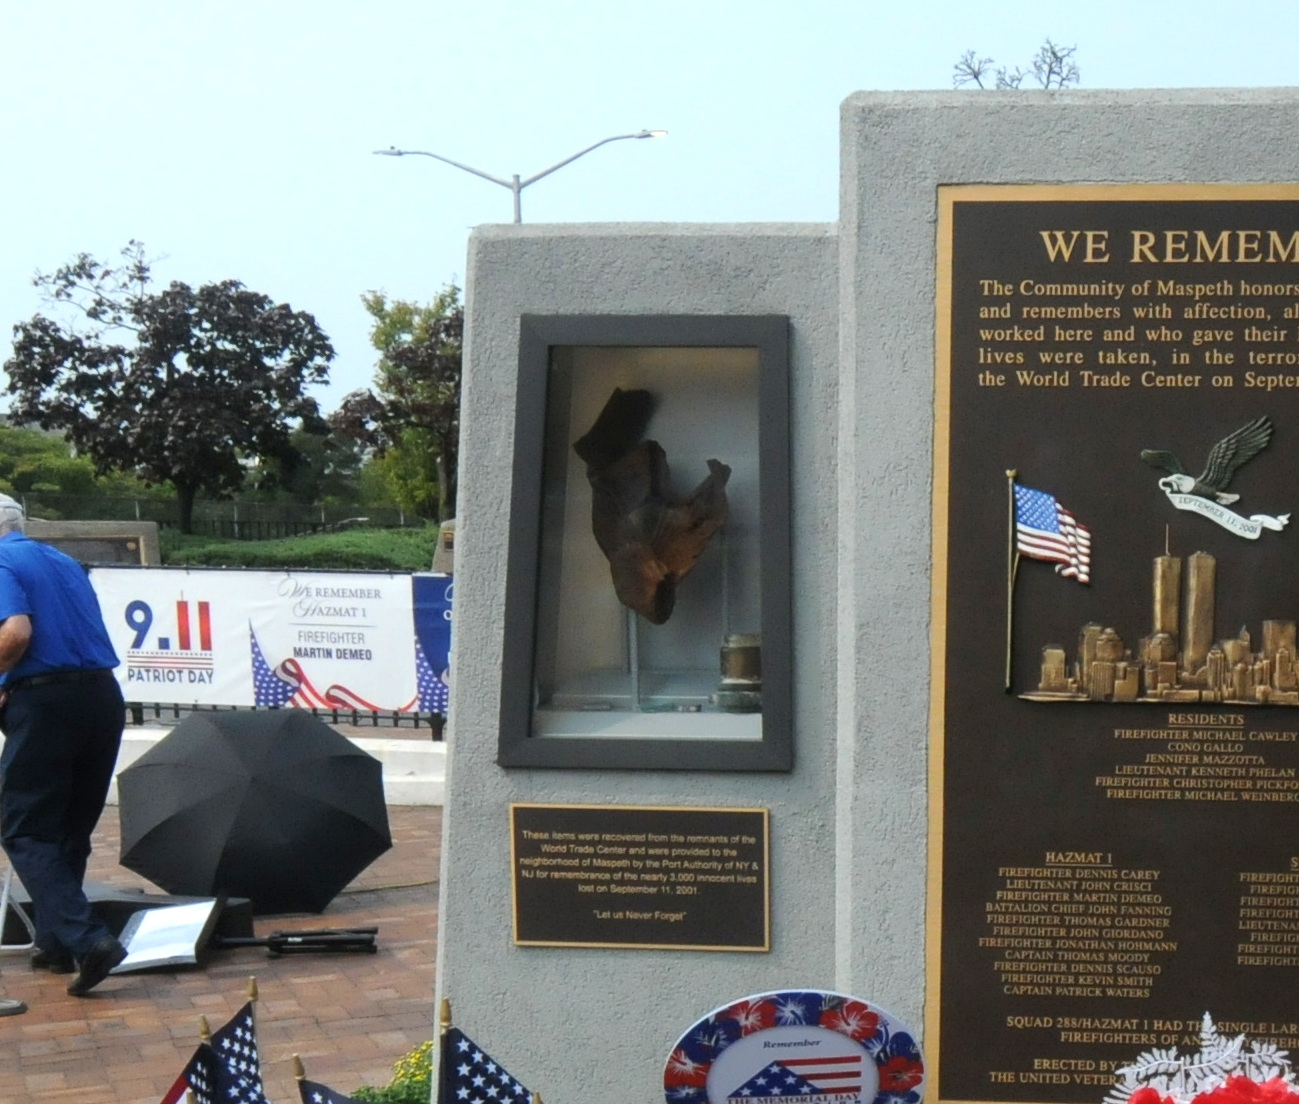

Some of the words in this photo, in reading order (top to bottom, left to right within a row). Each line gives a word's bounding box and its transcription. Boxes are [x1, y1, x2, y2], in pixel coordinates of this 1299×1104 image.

[1039, 230, 1109, 262] WE
[979, 279, 1013, 295] The
[1020, 279, 1124, 299] Community
[1131, 280, 1151, 295] of
[1157, 280, 1232, 299] Maspeth
[979, 302, 1010, 318] and
[1022, 302, 1120, 318] remembers
[1133, 302, 1171, 318] with
[1184, 303, 1270, 320] affection,
[979, 326, 1044, 340] worked
[1054, 326, 1092, 340] here
[1103, 326, 1134, 340] and
[1145, 326, 1182, 341] who
[1192, 330, 1233, 344] gave
[1244, 326, 1286, 341] their
[979, 349, 1023, 363] lives
[1039, 352, 1083, 363] were
[1098, 349, 1156, 365] taken,
[1172, 349, 1189, 363] in
[1205, 349, 1233, 364] the
[978, 370, 1005, 385] the
[1015, 370, 1068, 386] World
[1079, 370, 1130, 386] Trade
[1141, 371, 1201, 386] Center
[1212, 375, 1232, 386] on
[316, 587, 382, 599] REMEMBER
[293, 600, 358, 618] HAZMAT
[362, 609, 367, 618] 1
[125, 600, 212, 651] 9.11
[298, 631, 365, 645] FIREFIGHTER
[293, 647, 333, 659] MARTIN
[336, 648, 372, 661] DEMEO
[128, 669, 184, 683] PATRIOT
[188, 669, 214, 684] DAY
[1169, 714, 1243, 724] RESIDENTS
[1114, 729, 1189, 739] FIREFIGHTER
[1192, 730, 1245, 740] MICHAEL
[1249, 731, 1297, 740] CAWLEY
[1168, 742, 1200, 751] CONO
[1203, 743, 1243, 752] GALLO
[1145, 754, 1198, 763] JENNIFER
[1202, 755, 1264, 764] MAZZOTTA
[1115, 766, 1187, 775] LIEUTENANT
[1191, 767, 1245, 776] KENNETH
[1249, 767, 1294, 777] PHELAN
[1095, 777, 1169, 787] FIREFIGHTER
[1173, 778, 1252, 788] CHRISTOPHER
[1107, 790, 1180, 799] FIREFIGHTER
[1185, 791, 1237, 800] MICHAEL
[1046, 852, 1103, 864] HAZMAT
[1106, 853, 1112, 864] 1
[610, 884, 657, 894] September
[1006, 879, 1078, 889] LIEUTENANT
[1081, 881, 1110, 890] JOHN
[1114, 881, 1151, 891] CRISCI
[996, 891, 1069, 901] FIREFIGHTER
[1074, 893, 1117, 902] MARTIN
[1121, 894, 1161, 903] DEMEO
[625, 910, 652, 919] Never
[987, 915, 1059, 924] FIREFIGHTER
[1064, 916, 1111, 925] THOMAS
[1114, 917, 1169, 927] GARDNER
[993, 927, 1066, 936] FIREFIGHTER
[1070, 928, 1098, 937] JOHN
[1102, 929, 1163, 938] GIORDANO
[1005, 950, 1053, 959] CAPTAIN
[1057, 951, 1104, 960] THOMAS
[1108, 952, 1149, 962] MOODY
[1001, 973, 1074, 983] FIREFIGHTER
[1078, 975, 1113, 984] KEVIN
[1117, 976, 1152, 985] SMITH
[1003, 985, 1051, 994] CAPTAIN
[1056, 987, 1102, 996] PATRICK
[1106, 987, 1149, 997] WATERS
[1006, 1016, 1053, 1028] SQUAD
[1144, 1019, 1148, 1030] 1
[1154, 1020, 1183, 1031] HAD
[1217, 1022, 1267, 1033] SINGLE
[763, 1038, 822, 1049] Remember
[1060, 1031, 1156, 1044] FIREFIGHTERS
[1161, 1034, 1178, 1044] OF
[1034, 1059, 1095, 1071] ERECTED
[1099, 1061, 1118, 1071] BY
[989, 1072, 1015, 1083] THE
[1020, 1072, 1071, 1084] UNITED
[834, 1092, 860, 1102] DAY
